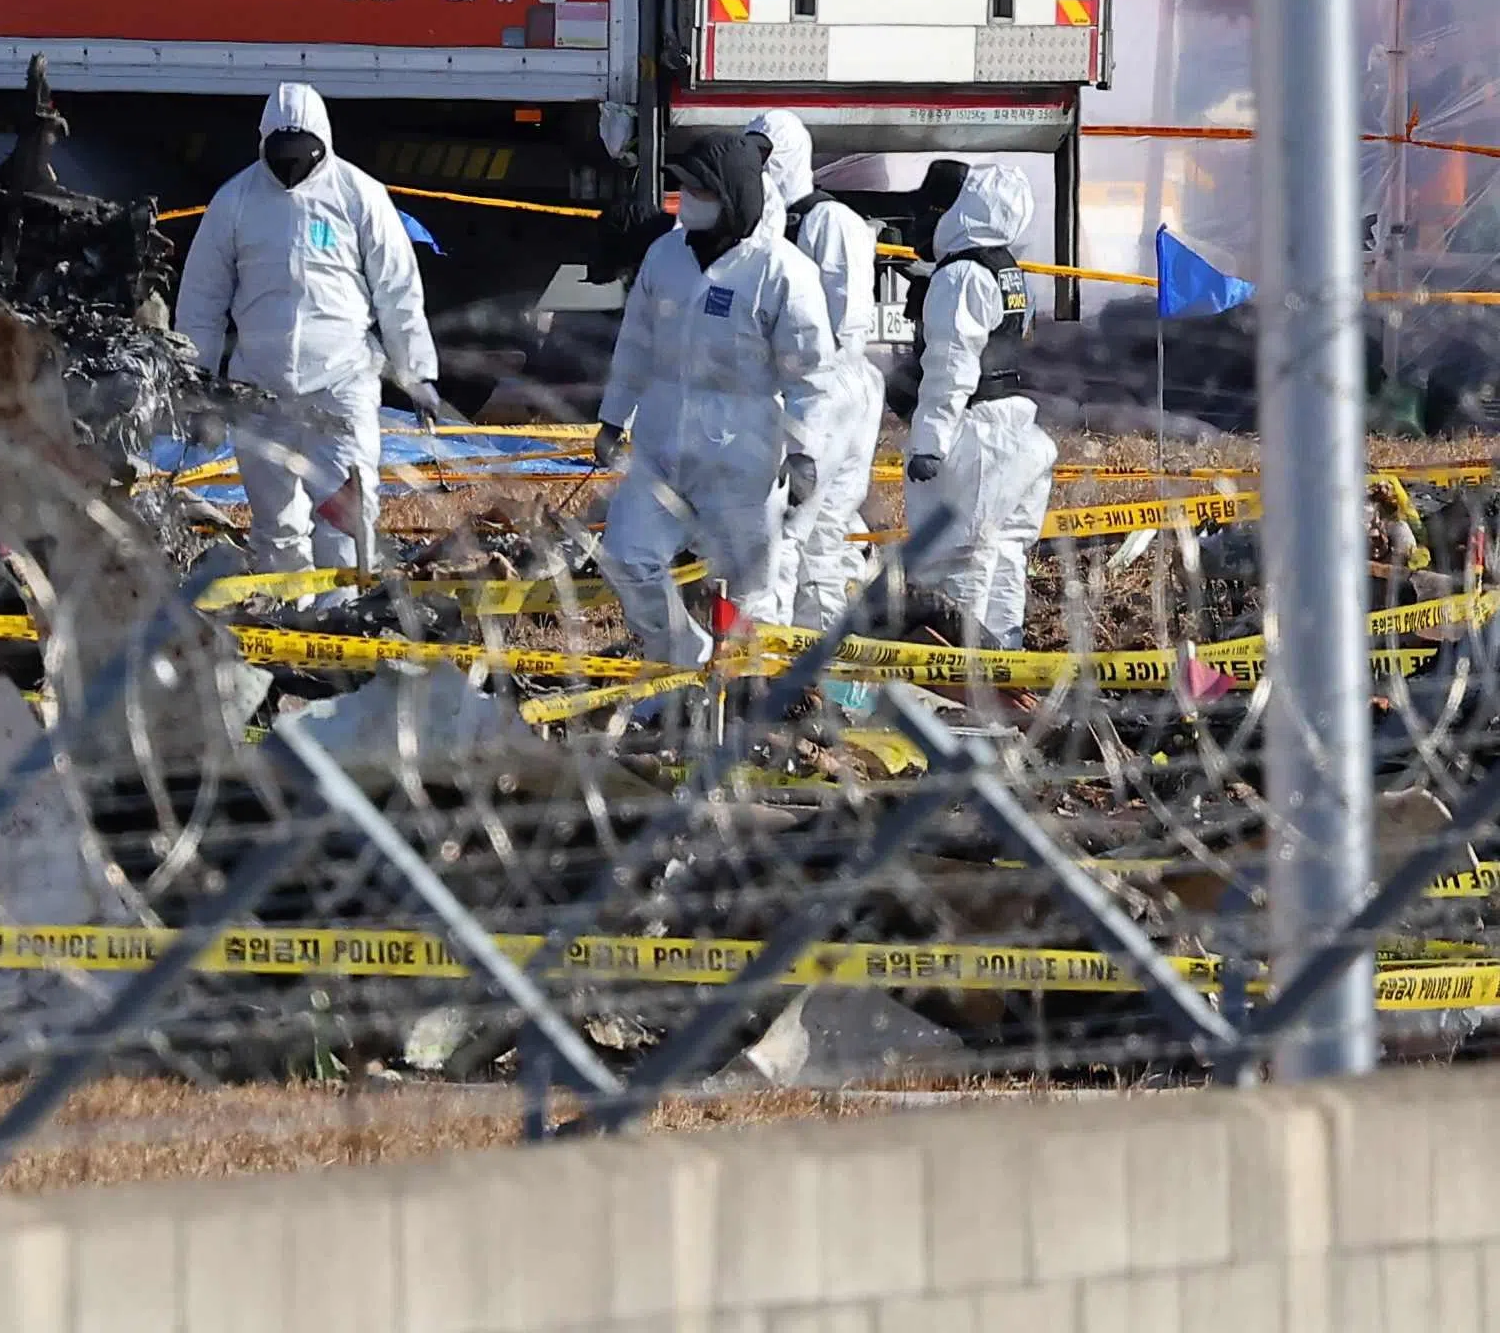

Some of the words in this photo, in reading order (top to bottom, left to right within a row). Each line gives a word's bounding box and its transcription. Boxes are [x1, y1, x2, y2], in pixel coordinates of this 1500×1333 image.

[17, 933, 98, 961] POLICE
[224, 934, 320, 965] 출입금지
[333, 938, 415, 967] POLICE
[653, 946, 737, 973] POLICE
[975, 954, 1057, 981] POLICE
[1068, 957, 1118, 982] LINE
[1419, 975, 1452, 1000] POLICE
[1454, 974, 1474, 999] LINE
